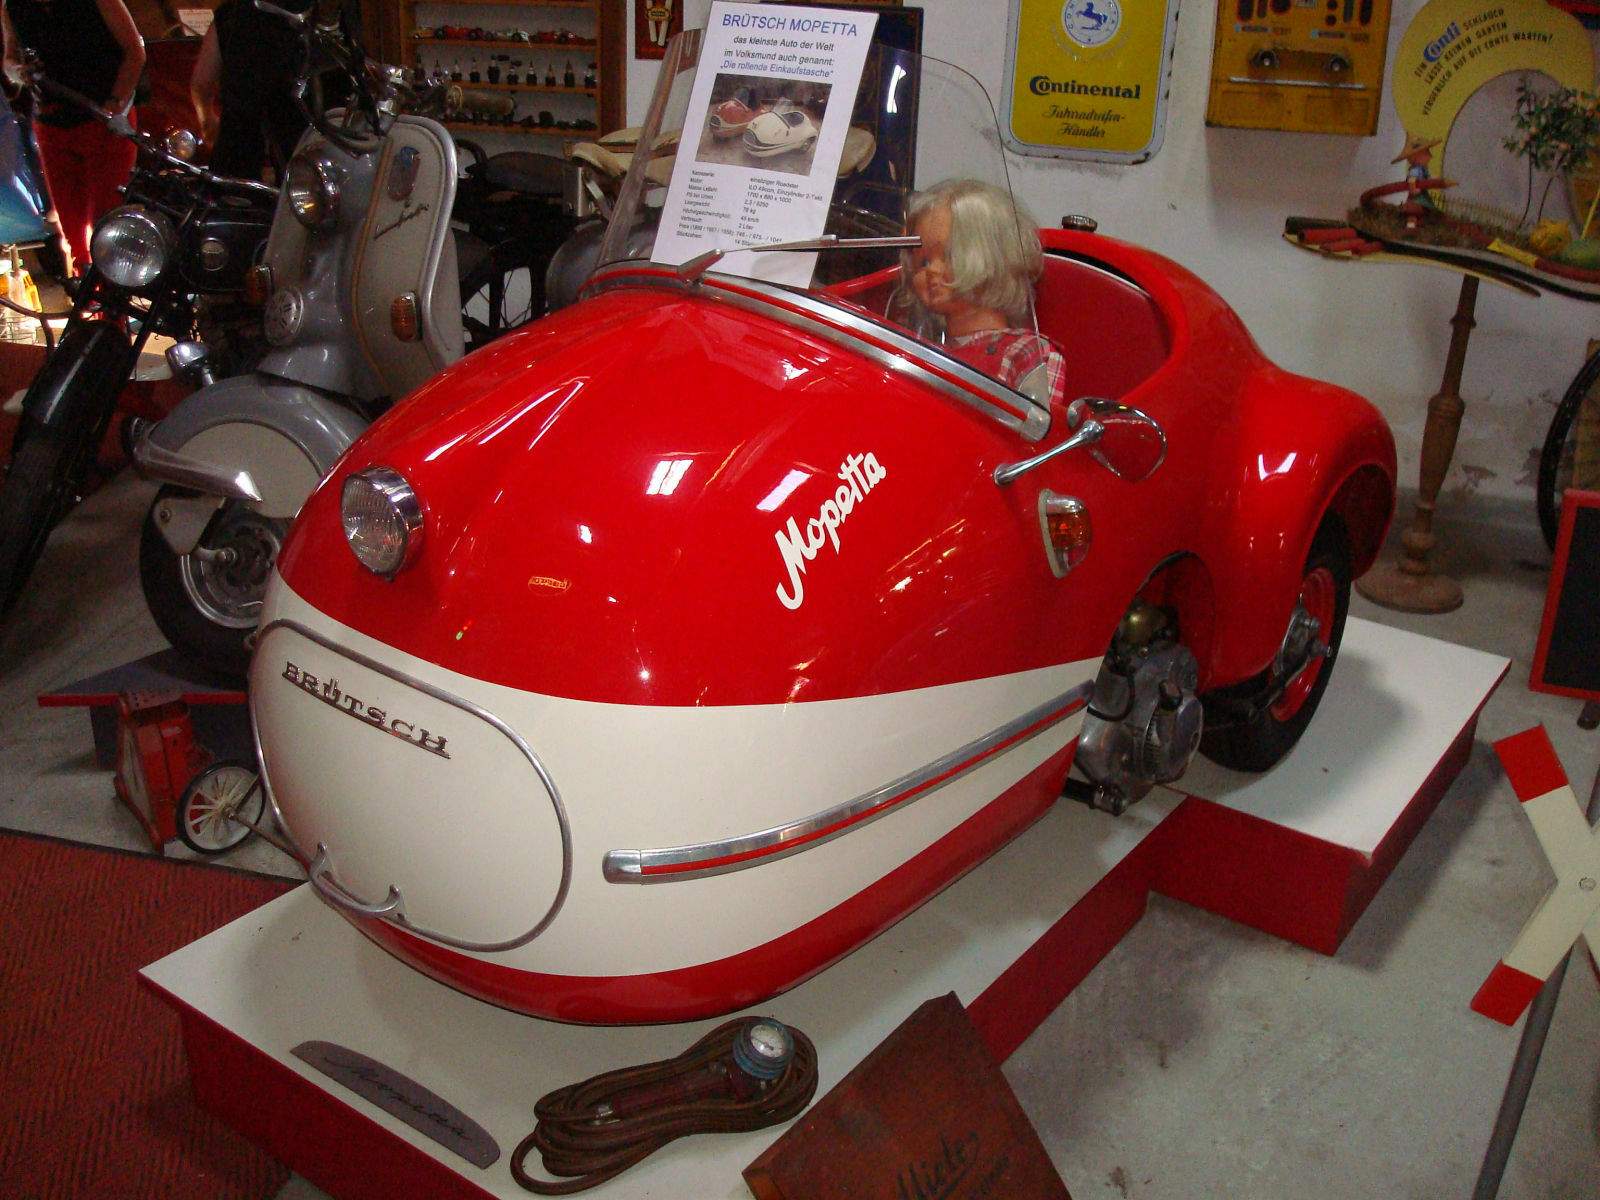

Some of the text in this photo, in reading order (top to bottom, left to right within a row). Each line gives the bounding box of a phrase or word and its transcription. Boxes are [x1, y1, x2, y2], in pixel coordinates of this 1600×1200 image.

[722, 13, 858, 37] BRÜTSCH MOPETTA
[733, 35, 834, 51] das kleinste Auto der Welt
[1423, 20, 1461, 62] Conti
[724, 48, 835, 67] im Volksmund auch genannt:
[737, 61, 767, 72] rollende
[1029, 74, 1141, 99] Continental
[775, 450, 888, 611] Mopetta
[282, 661, 449, 758] BRÜTSCH
